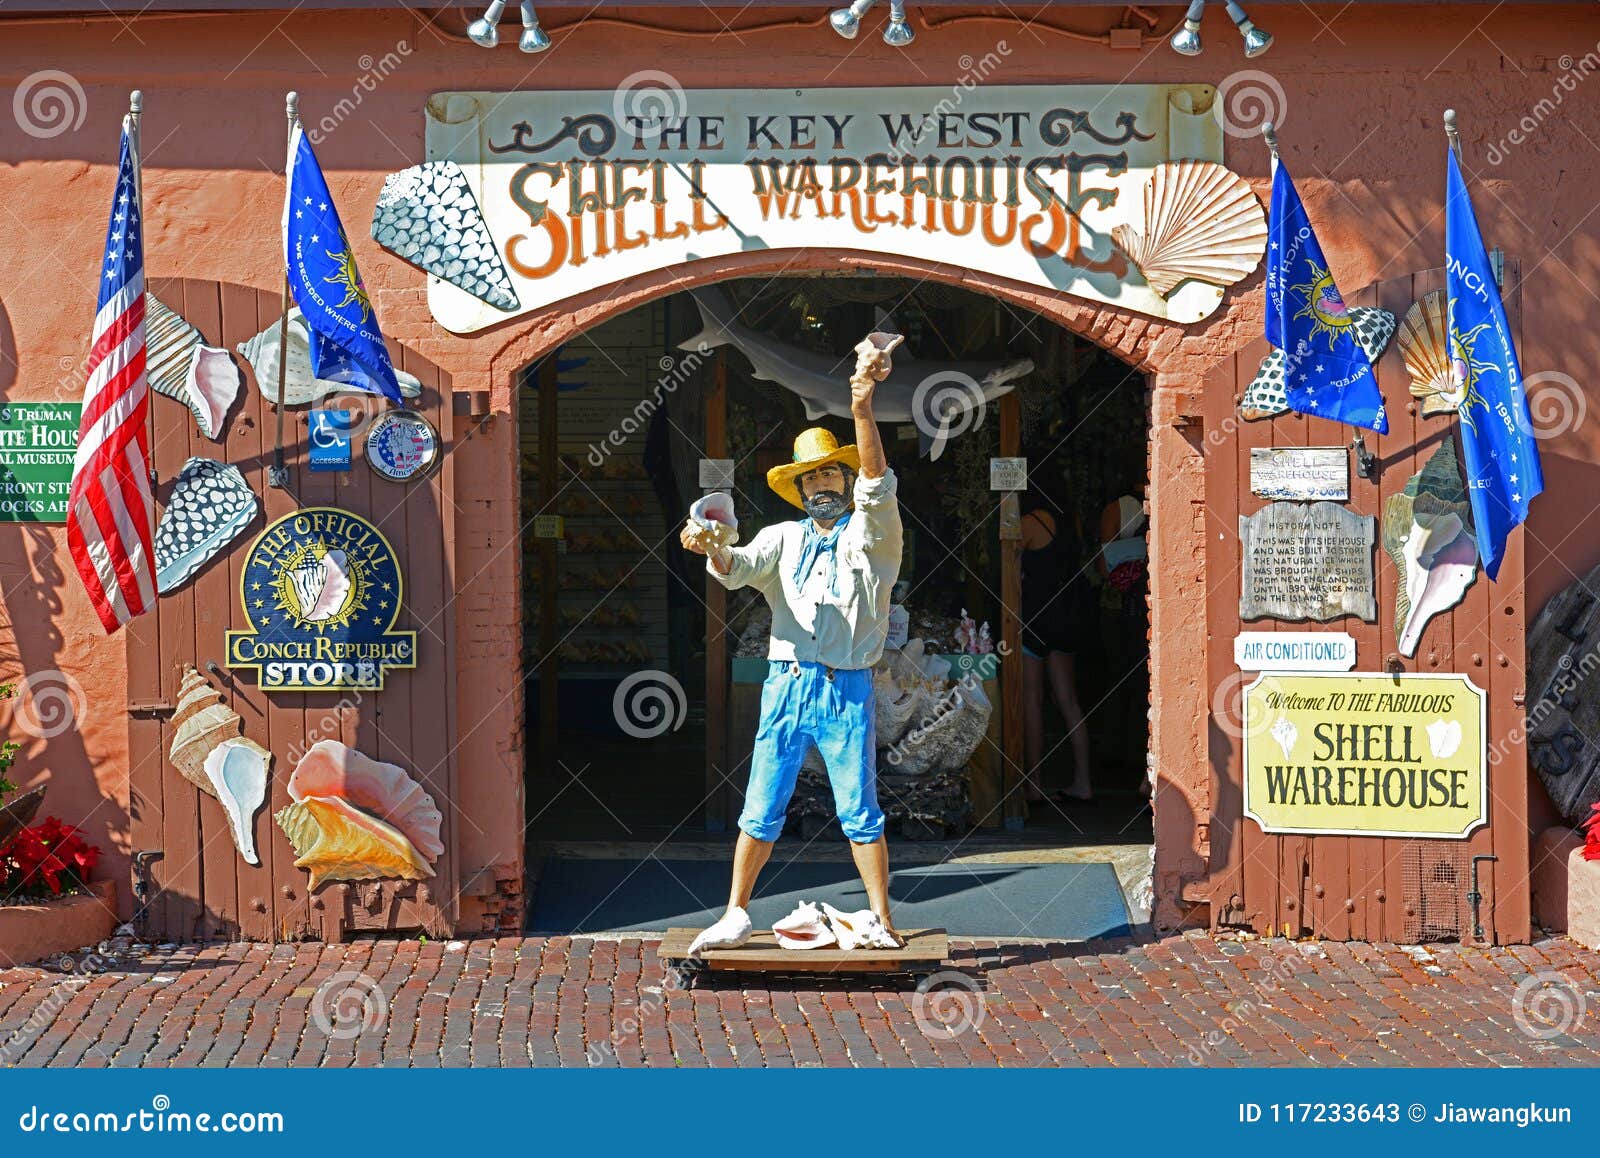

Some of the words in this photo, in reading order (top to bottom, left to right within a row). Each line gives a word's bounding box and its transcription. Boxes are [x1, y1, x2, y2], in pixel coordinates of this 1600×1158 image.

[624, 115, 725, 151] THE
[746, 114, 854, 150] KEY
[878, 111, 1031, 149] WEST
[504, 155, 729, 280] SHELL
[744, 150, 1129, 281] WAREHOUSE
[298, 261, 325, 306] SECEDED
[324, 305, 358, 332] WHERE
[360, 330, 384, 345] OTHE
[14, 408, 72, 421] TRUMAN
[1494, 401, 1516, 435] 1982
[31, 424, 80, 447] HOUS
[17, 453, 76, 465] MUSEUM
[0, 500, 45, 513] OCKS
[1314, 522, 1341, 530] NOTE
[252, 525, 292, 570] THE
[294, 512, 389, 572] OFFICIAL
[1253, 547, 1274, 555] AND
[1276, 547, 1296, 555] WAS
[1299, 547, 1322, 555] BUILT
[1326, 547, 1337, 555] TO
[1339, 547, 1365, 555] STORE
[1257, 537, 1276, 546] THIS
[1279, 537, 1295, 546] WAS
[1339, 537, 1366, 546] HOUSE
[1253, 557, 1270, 566] THE
[1273, 557, 1319, 566] NATURAL
[1322, 557, 1335, 566] ICE
[1337, 557, 1364, 566] WHICH
[1253, 567, 1272, 576] WAS
[1275, 567, 1318, 576] BROUGHT
[1322, 567, 1332, 576] IN
[1335, 567, 1363, 576] SHIPS
[1253, 577, 1279, 585] FROM
[1281, 577, 1301, 585] NEW
[1304, 577, 1349, 585] ENGLAND
[1253, 585, 1282, 593] UNTIL
[1309, 585, 1326, 593] WAS
[1329, 585, 1342, 593] ICE
[1345, 585, 1369, 593] MADE
[232, 637, 312, 663] CONCH
[313, 637, 412, 663] REPUBLIC
[1243, 642, 1265, 660] AIR
[1265, 642, 1347, 661] CONDITIONED
[265, 662, 378, 686] STORE
[1265, 691, 1325, 711] Welcome
[1327, 692, 1344, 711] TO
[1347, 692, 1374, 712] THE
[1375, 693, 1455, 713] FABULOUS
[1313, 722, 1422, 764] SHELL
[1263, 765, 1470, 809] WAREHOUSE
